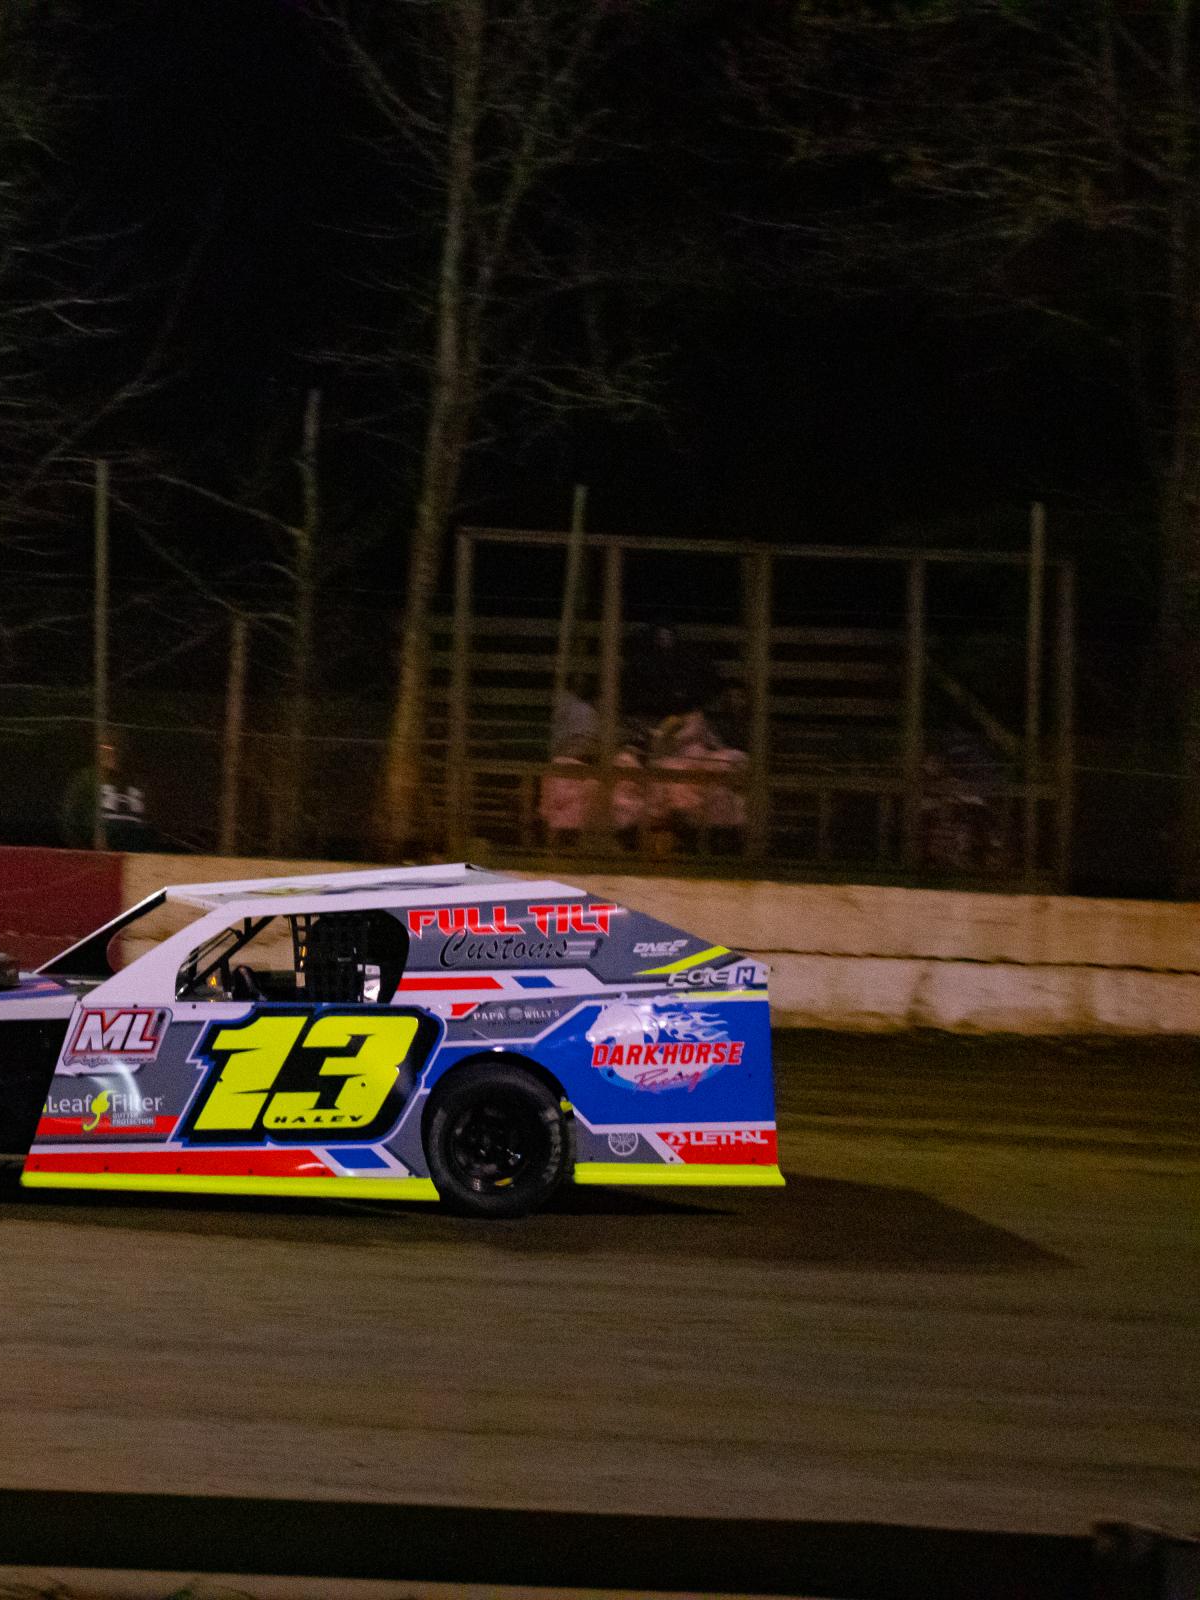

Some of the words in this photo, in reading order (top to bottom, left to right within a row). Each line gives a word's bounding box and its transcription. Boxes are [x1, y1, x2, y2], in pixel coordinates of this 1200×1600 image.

[407, 905, 526, 939] FULL
[528, 903, 618, 938] TILT
[439, 928, 570, 967] Customs
[473, 1010, 505, 1020] PAPA
[73, 1012, 156, 1052] ML
[193, 1016, 419, 1131] 13
[48, 1094, 92, 1112] Leaf
[274, 1114, 364, 1124] HALEY
[690, 1130, 769, 1145] LETHAL
